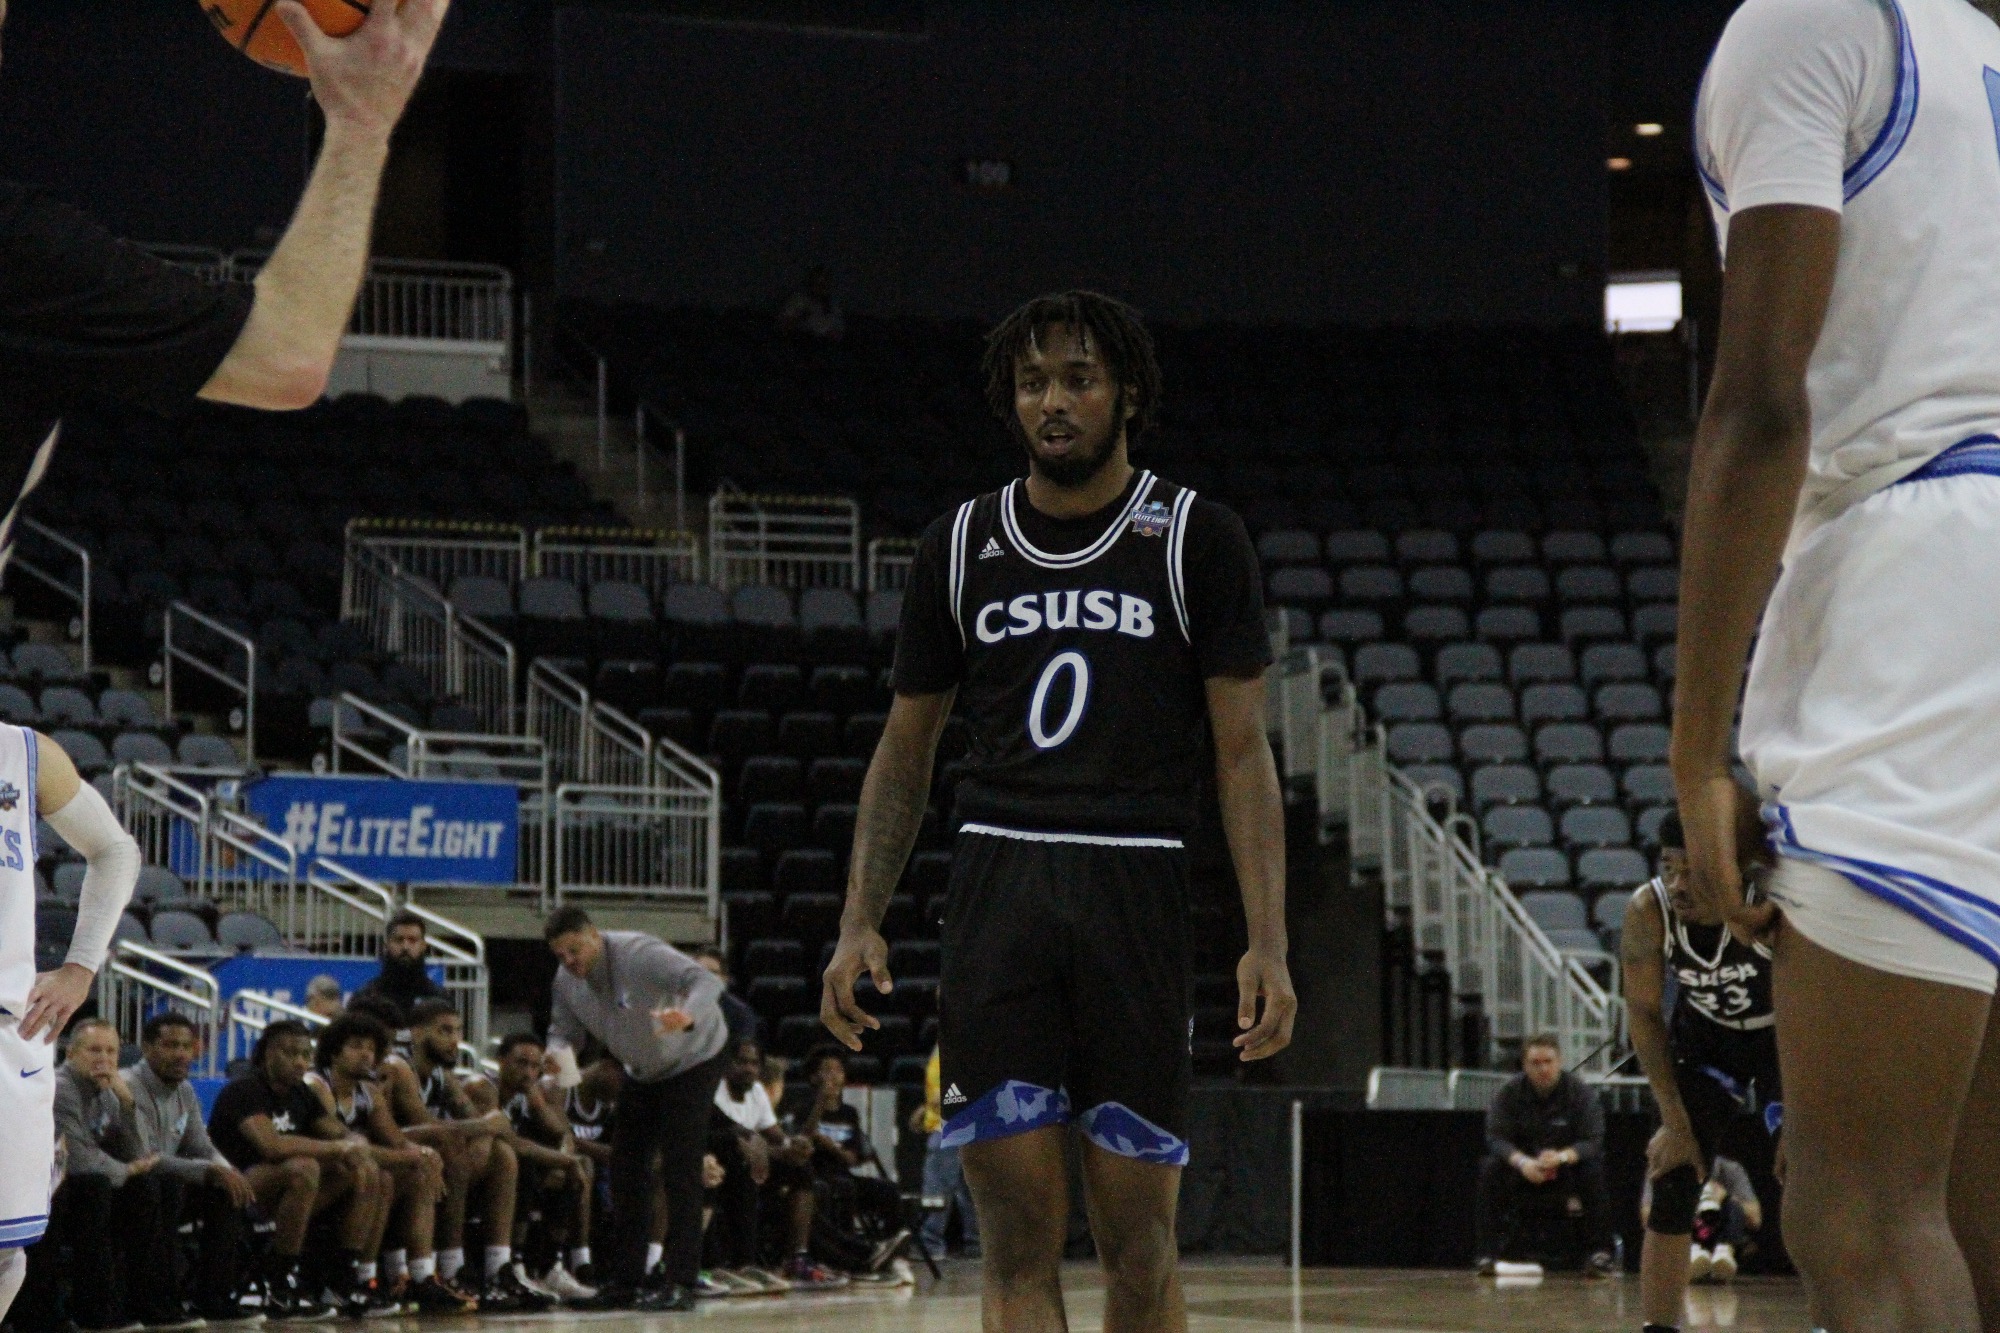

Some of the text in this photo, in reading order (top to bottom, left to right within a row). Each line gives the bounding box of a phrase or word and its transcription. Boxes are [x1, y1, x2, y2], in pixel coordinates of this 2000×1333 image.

[978, 549, 1005, 560] adidas
[976, 590, 1155, 643] CSUSB
[1028, 651, 1089, 748] 0
[943, 1095, 968, 1105] adidas
